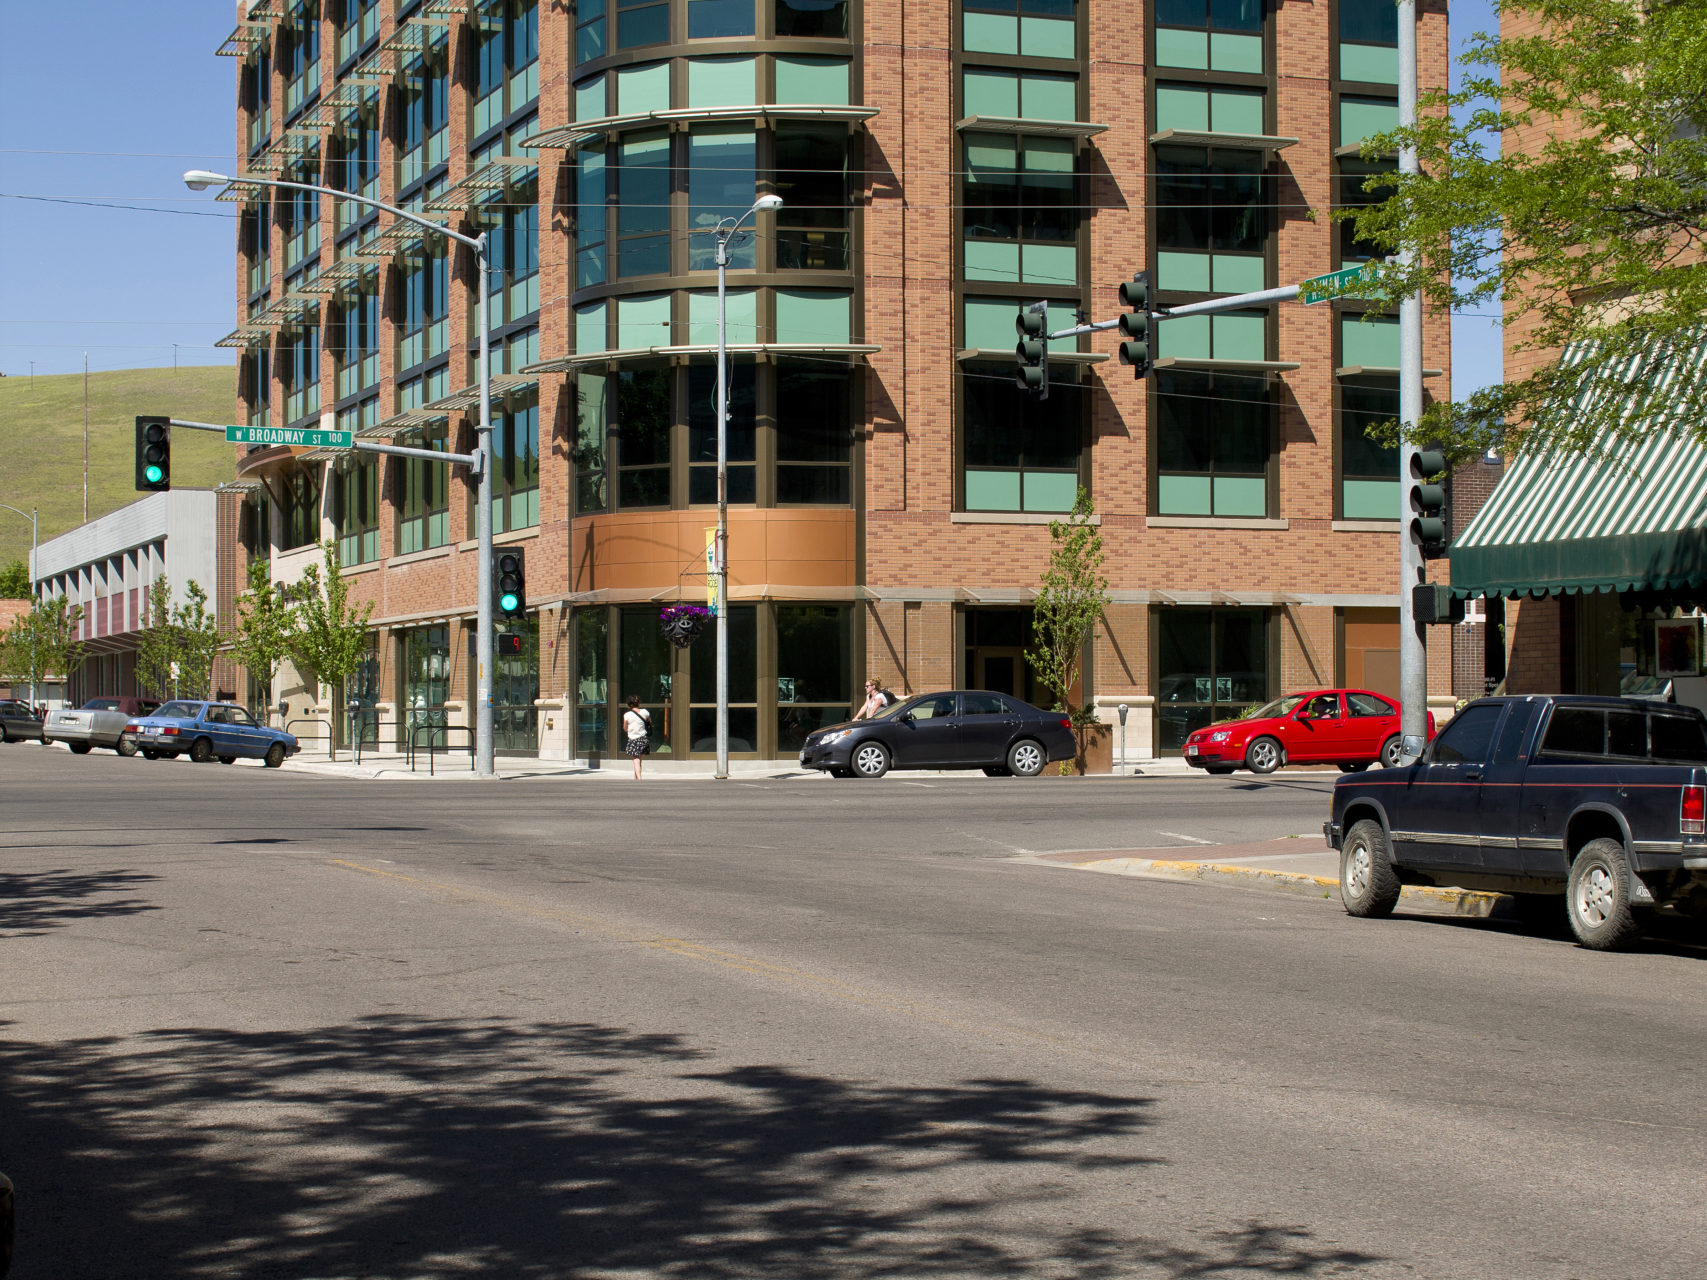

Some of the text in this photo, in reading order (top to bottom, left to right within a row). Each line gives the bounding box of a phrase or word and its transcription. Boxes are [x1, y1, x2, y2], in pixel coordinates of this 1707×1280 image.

[235, 428, 342, 444] W BROADWAY ST 100
[513, 637, 520, 651] 9
